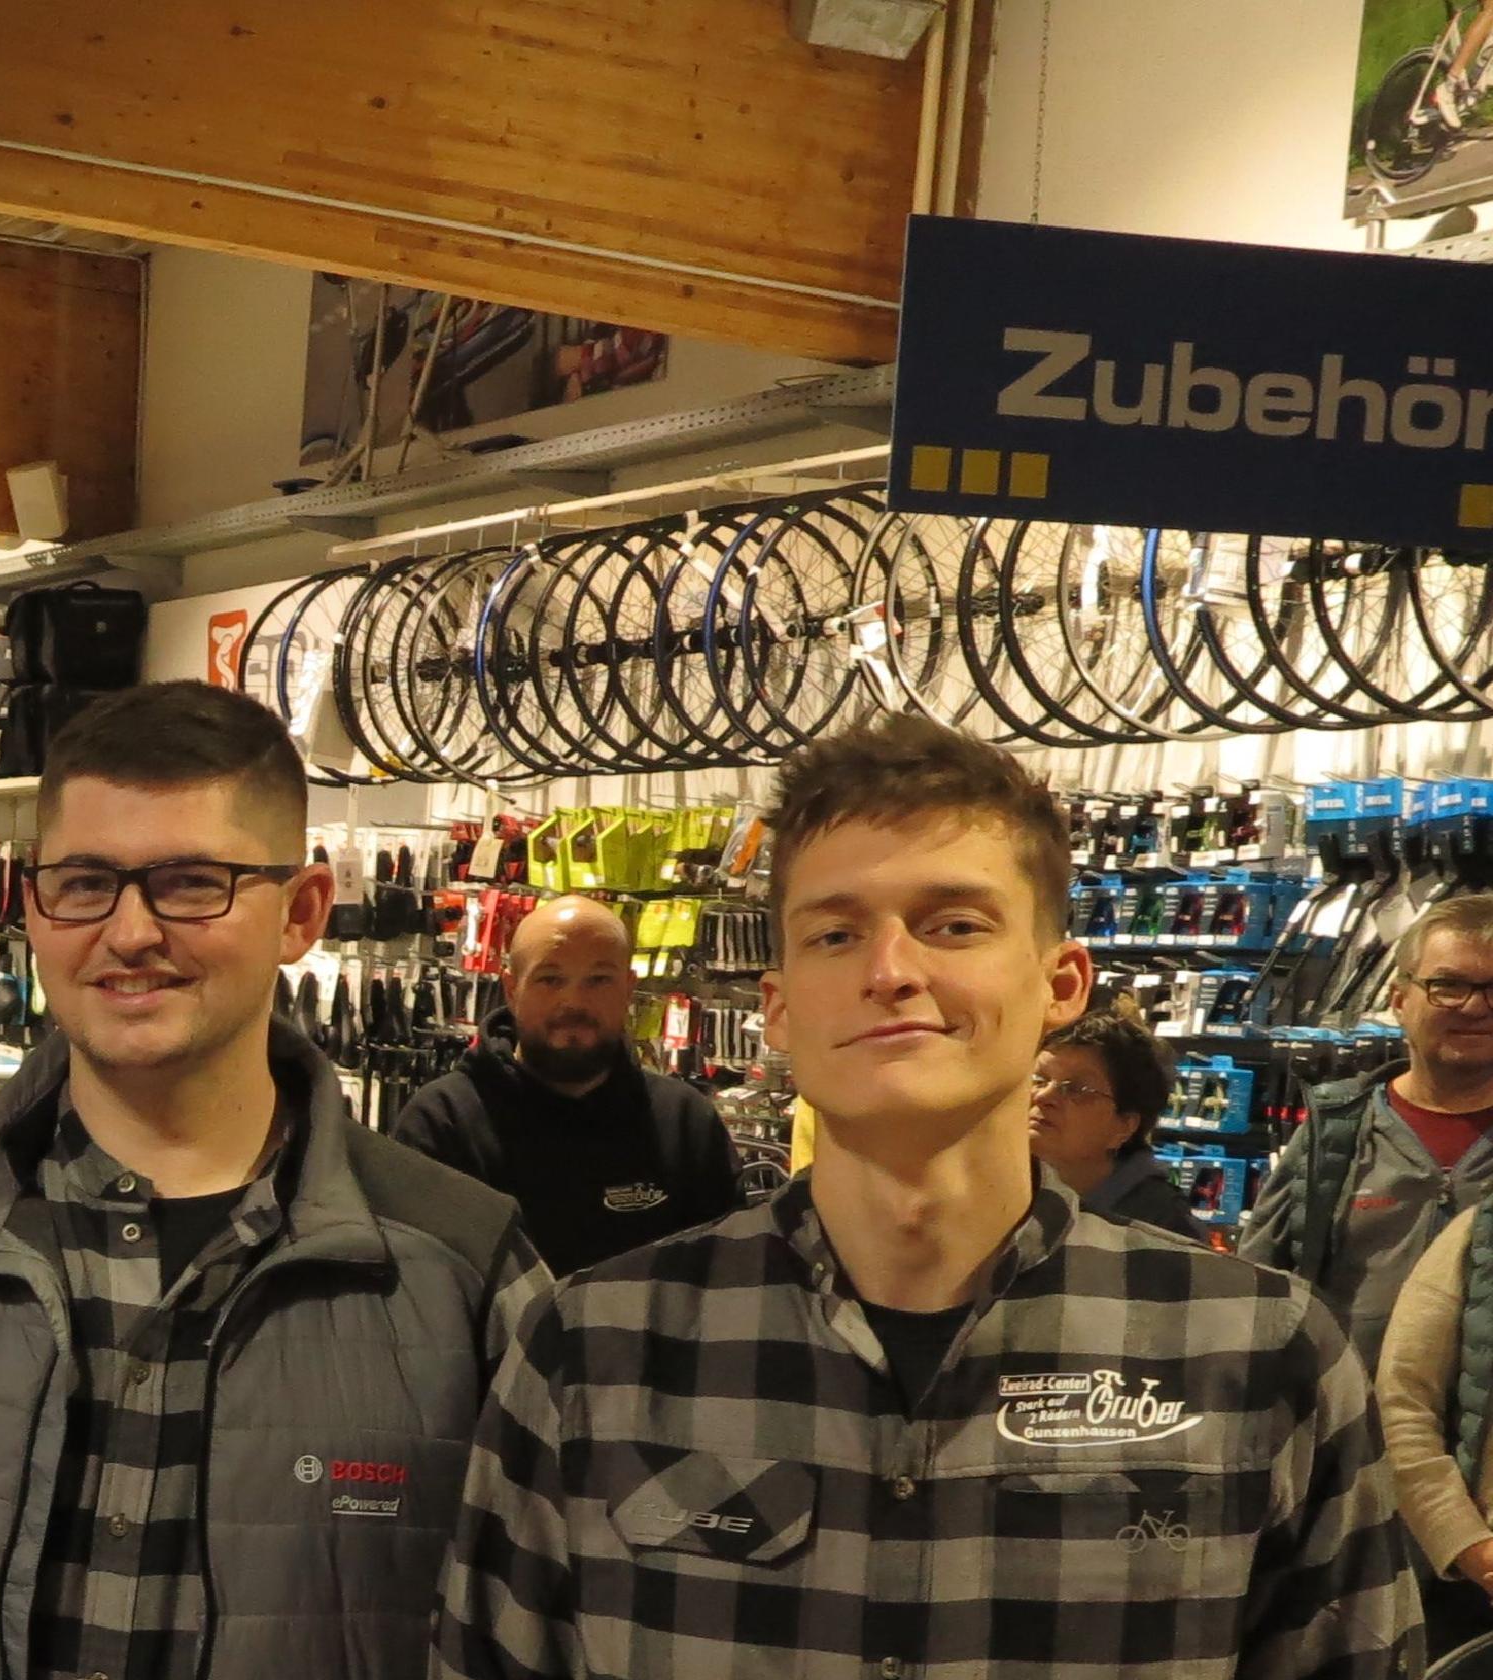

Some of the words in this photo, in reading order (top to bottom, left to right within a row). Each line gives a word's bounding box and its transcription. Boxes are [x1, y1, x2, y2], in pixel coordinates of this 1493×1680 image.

[996, 327, 1493, 451] Zubehör
[1001, 1376, 1087, 1391] Zweirad-Center
[1015, 1399, 1045, 1412] Stark
[1047, 1395, 1069, 1407] auf
[1086, 1371, 1185, 1428] Gruber
[1029, 1412, 1038, 1424] 2
[1040, 1408, 1081, 1422] Rädern
[1024, 1425, 1137, 1438] Gunzenhausen
[330, 1461, 406, 1484] BOSCH
[333, 1495, 400, 1511] ePowered
